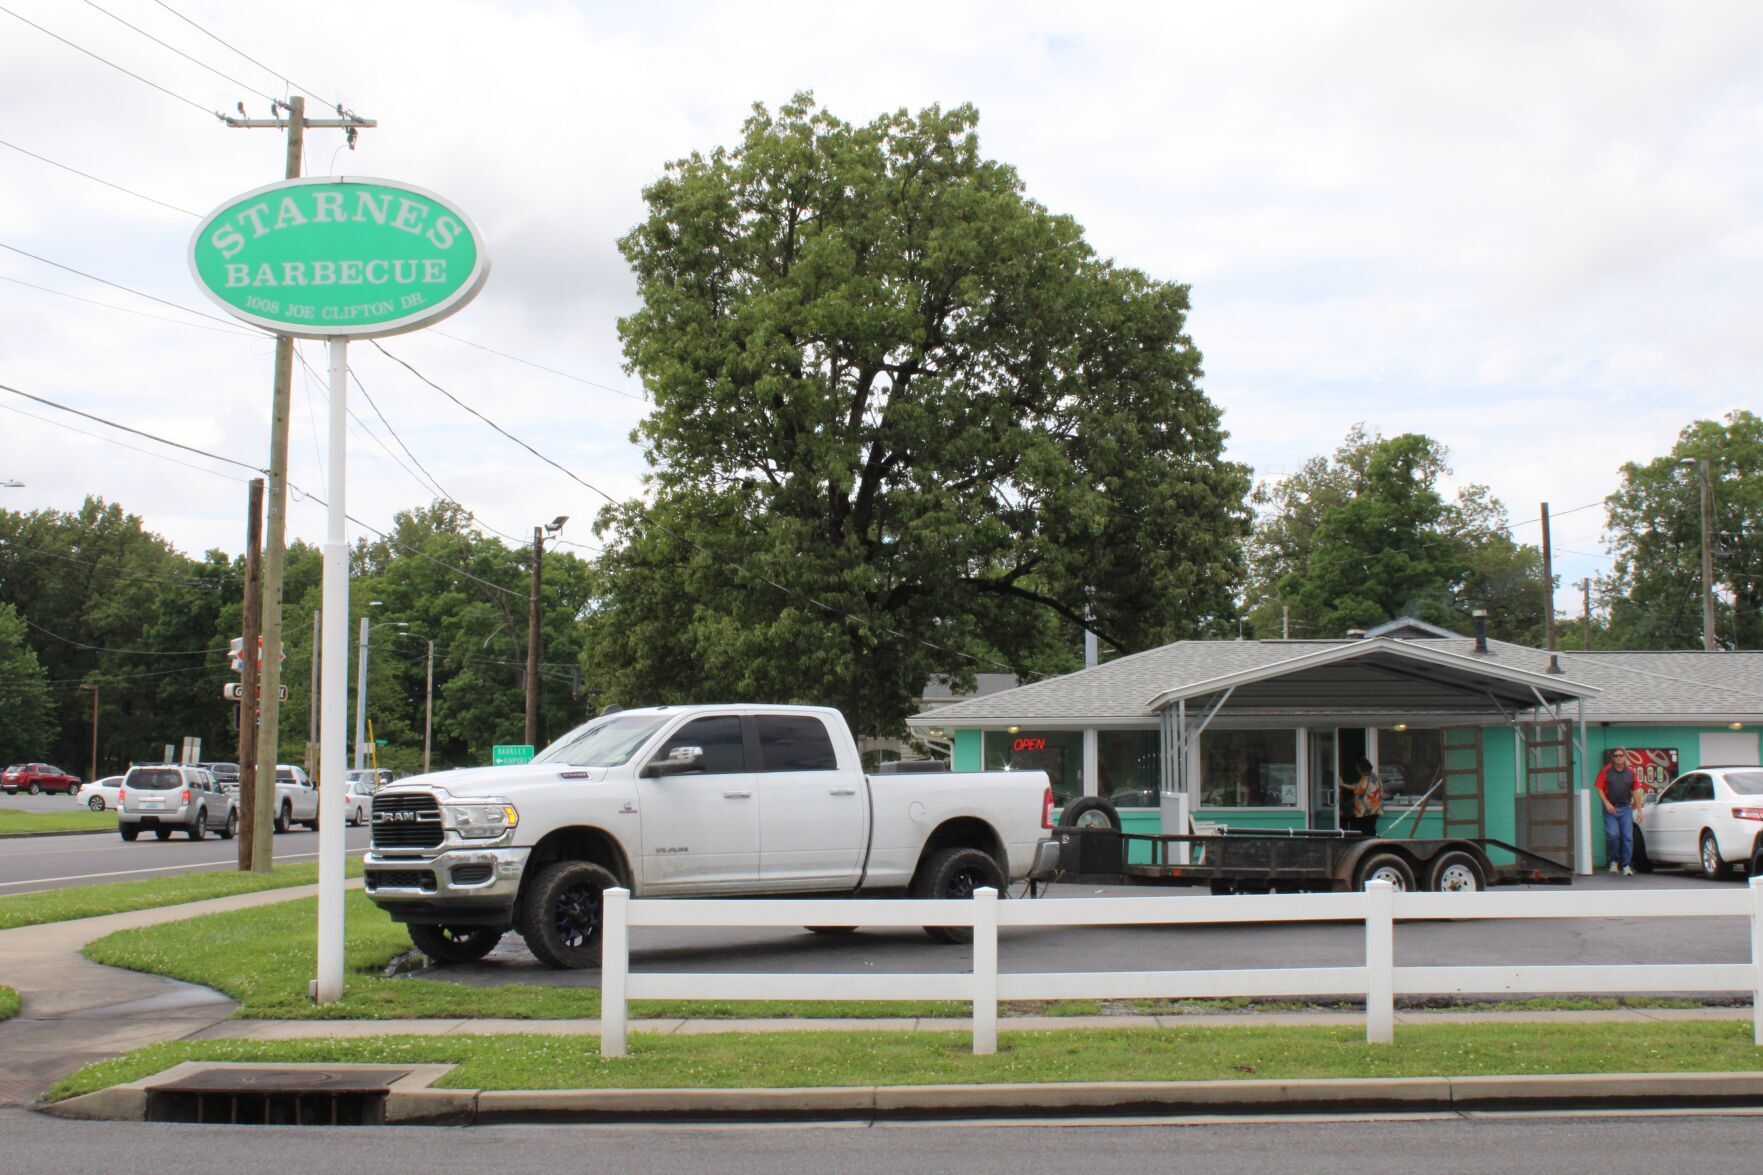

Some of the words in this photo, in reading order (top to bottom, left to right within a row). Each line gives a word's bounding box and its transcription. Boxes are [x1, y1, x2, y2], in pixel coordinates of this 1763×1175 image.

[211, 191, 463, 259] STARNES
[224, 259, 447, 287] BARBECUE
[245, 295, 280, 314] 1008
[285, 303, 315, 319] JOE
[322, 300, 395, 320] CLIFTON
[1013, 738, 1046, 751] OPEN
[383, 812, 415, 822] RAM
